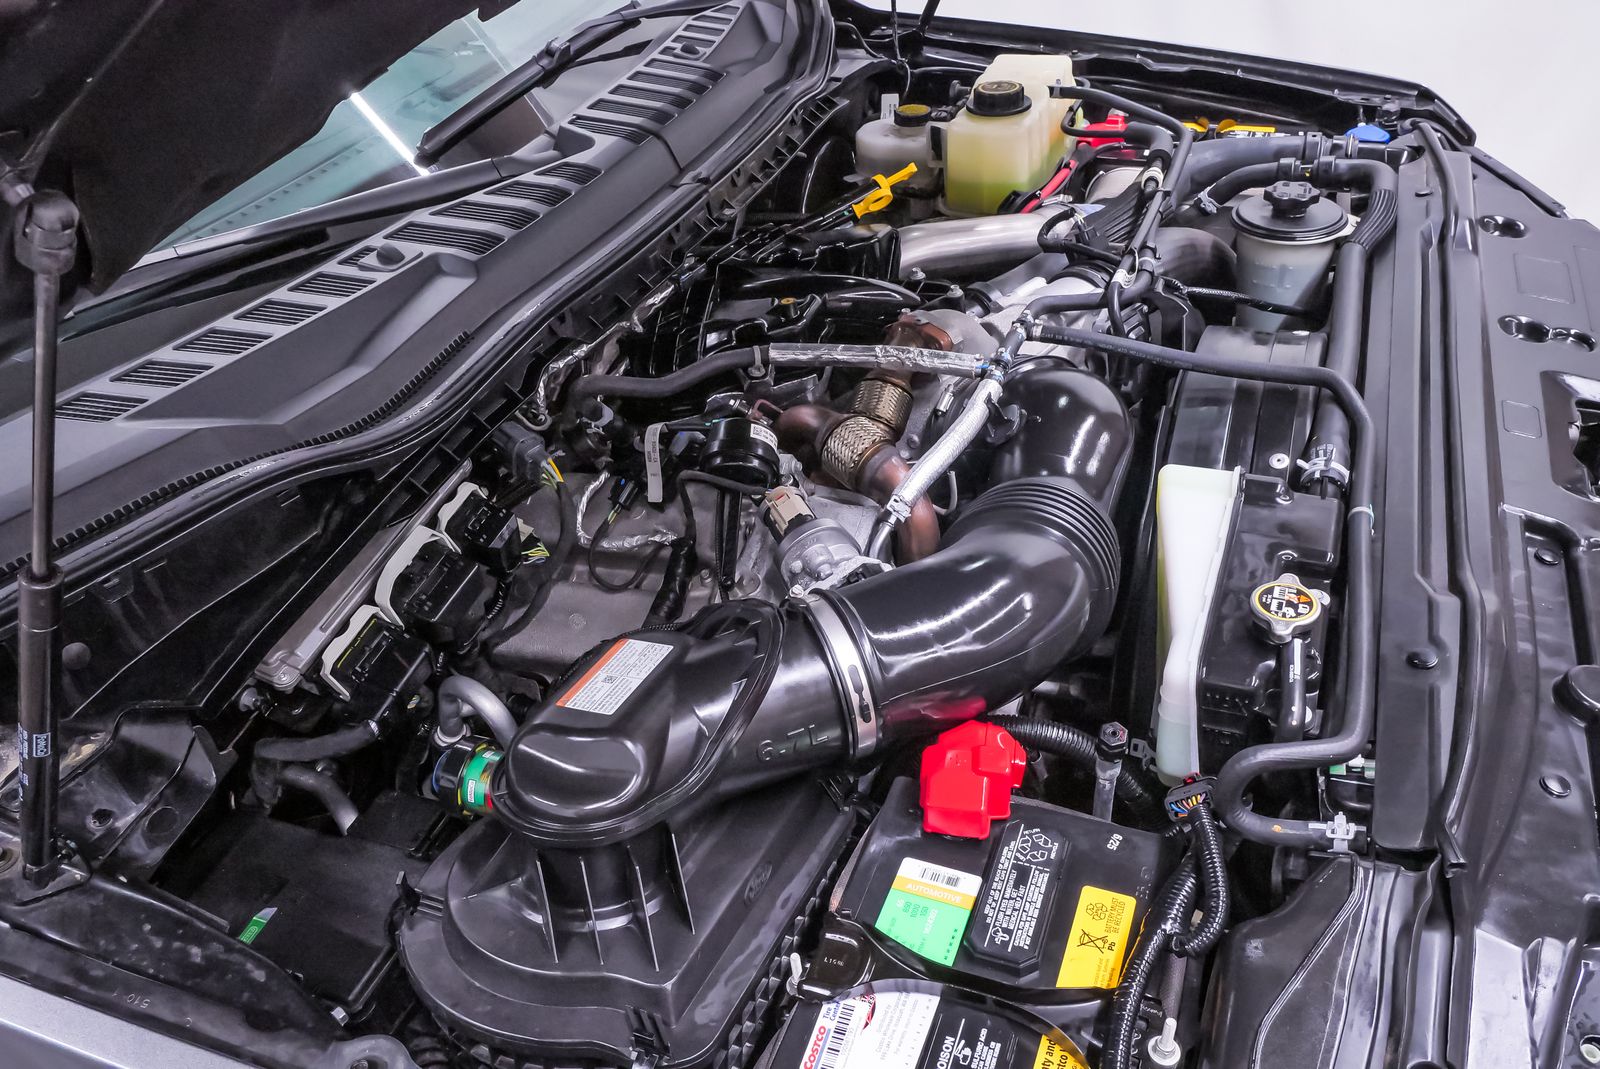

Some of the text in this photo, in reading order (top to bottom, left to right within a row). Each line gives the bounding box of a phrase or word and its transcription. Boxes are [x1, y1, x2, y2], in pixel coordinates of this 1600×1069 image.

[1107, 834, 1123, 850] 6/25
[906, 883, 962, 903] AUTOMOTIVE
[910, 904, 920, 918] 1000
[1000, 899, 1008, 911] EYES
[1008, 885, 1026, 930] MEDICAL HELP FAST
[1114, 901, 1126, 926] RECYCLED
[1105, 897, 1119, 933] BATTERY MUST
[1108, 941, 1116, 951] Pb
[823, 1007, 832, 1019] Tire
[830, 1001, 841, 1022] Center
[979, 1028, 988, 1042] ACID
[804, 1026, 826, 1069] COSTCO
[936, 1036, 955, 1069] OISON
[1046, 1039, 1056, 1056] and
